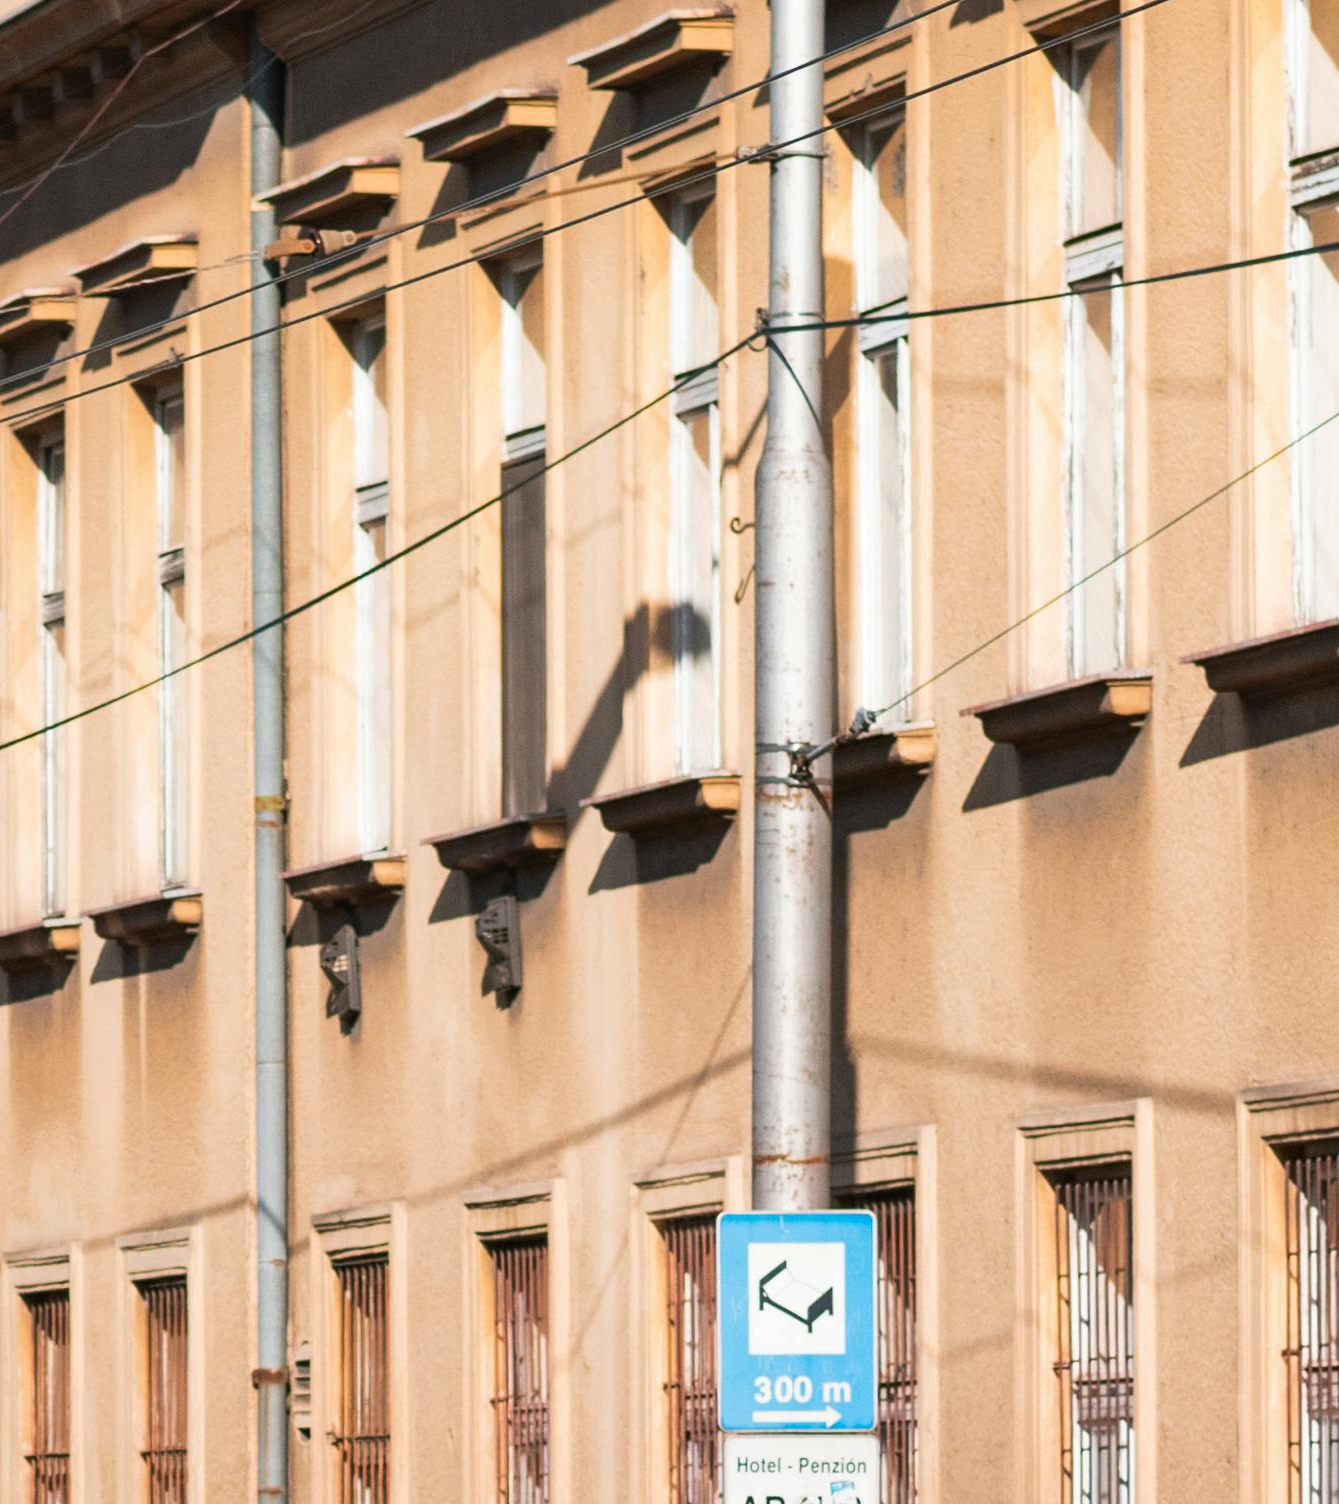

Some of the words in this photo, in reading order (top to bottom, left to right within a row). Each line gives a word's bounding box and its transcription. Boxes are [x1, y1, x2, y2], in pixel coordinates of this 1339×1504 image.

[753, 1375, 813, 1404] 300
[822, 1381, 851, 1403] m
[737, 1457, 781, 1473] Hotel
[799, 1457, 867, 1474] Penzión
